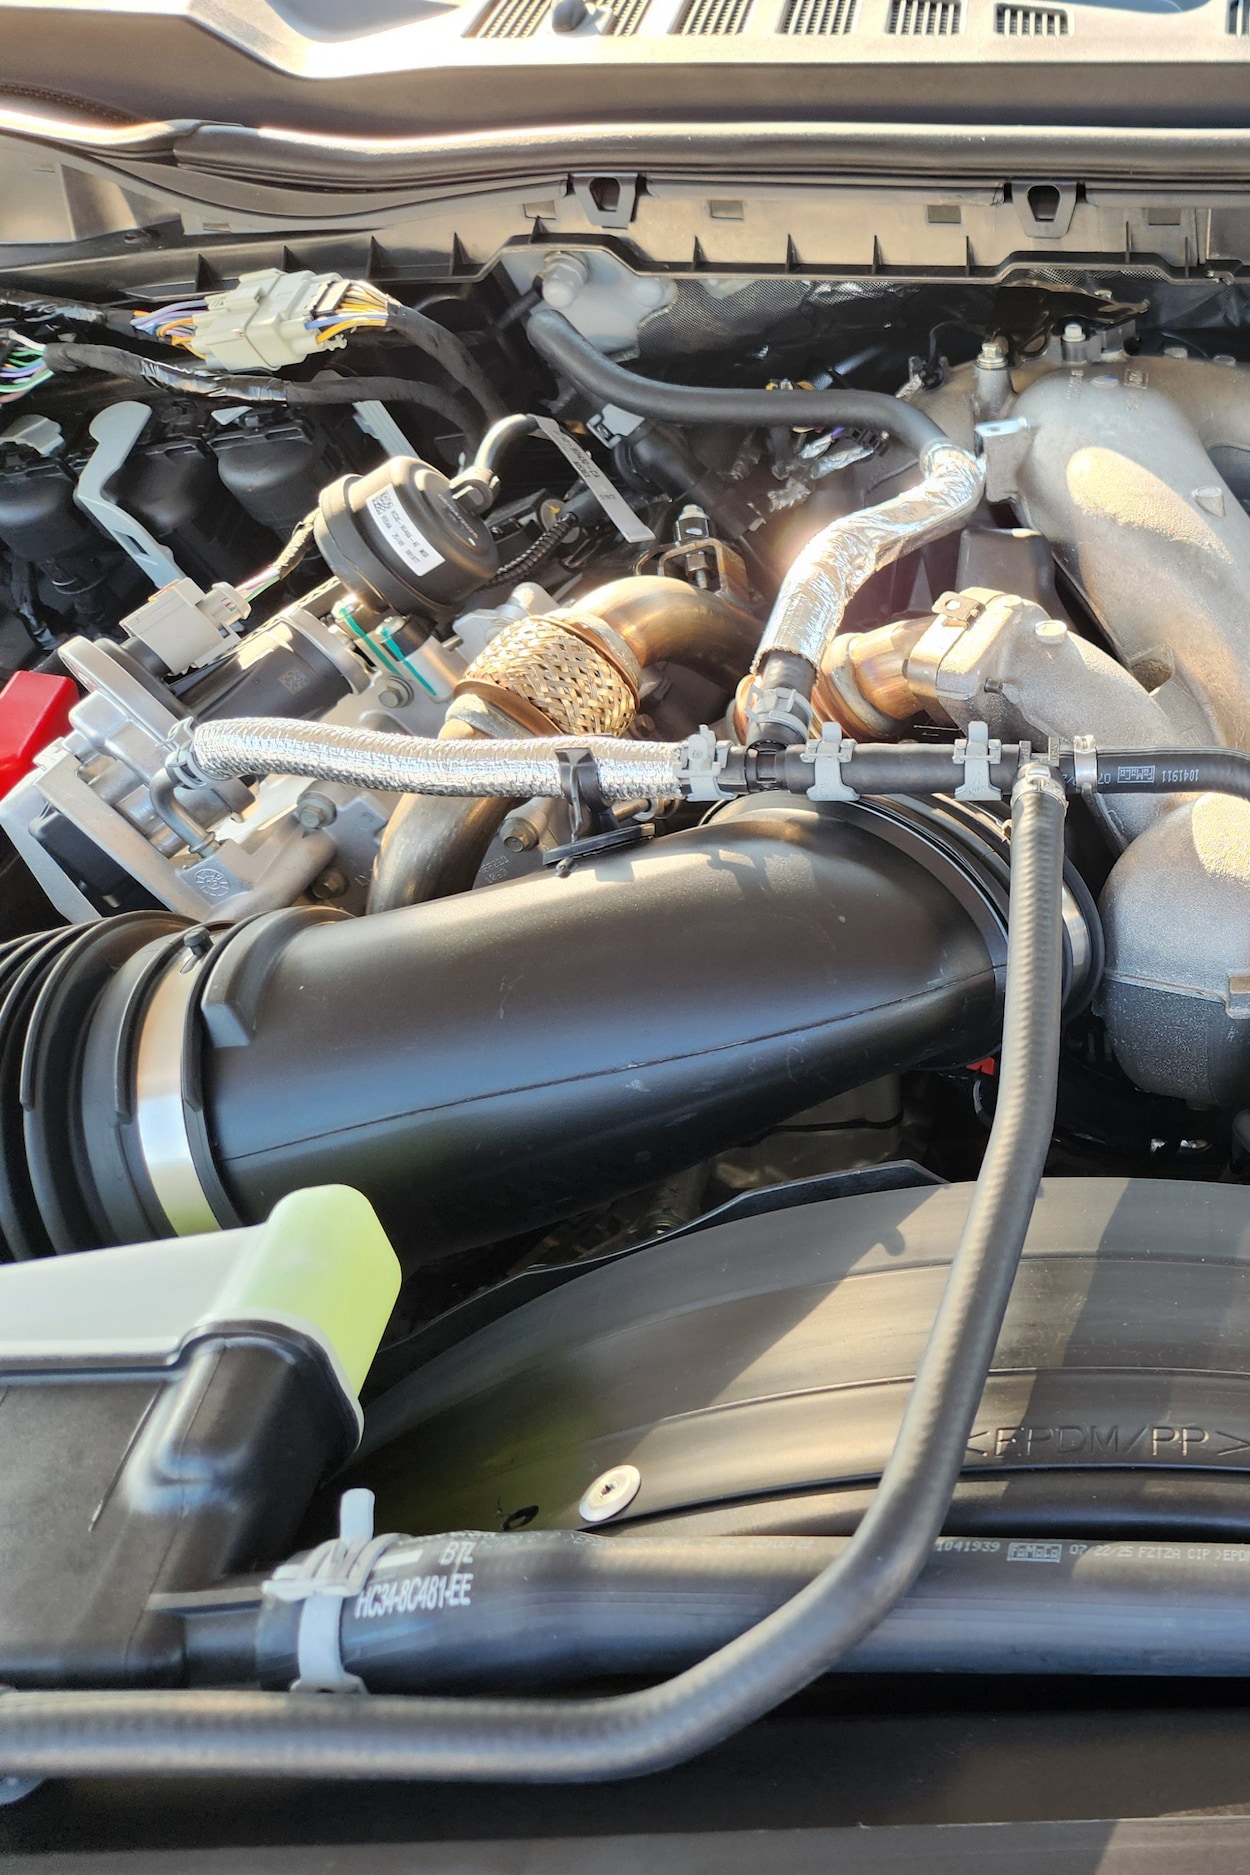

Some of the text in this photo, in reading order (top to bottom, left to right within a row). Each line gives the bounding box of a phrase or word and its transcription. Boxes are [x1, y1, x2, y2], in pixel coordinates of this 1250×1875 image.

[1162, 769, 1199, 783] 1041911
[1187, 1548, 1211, 1562] CIP
[354, 1573, 474, 1619] HC34-8C481-EE
